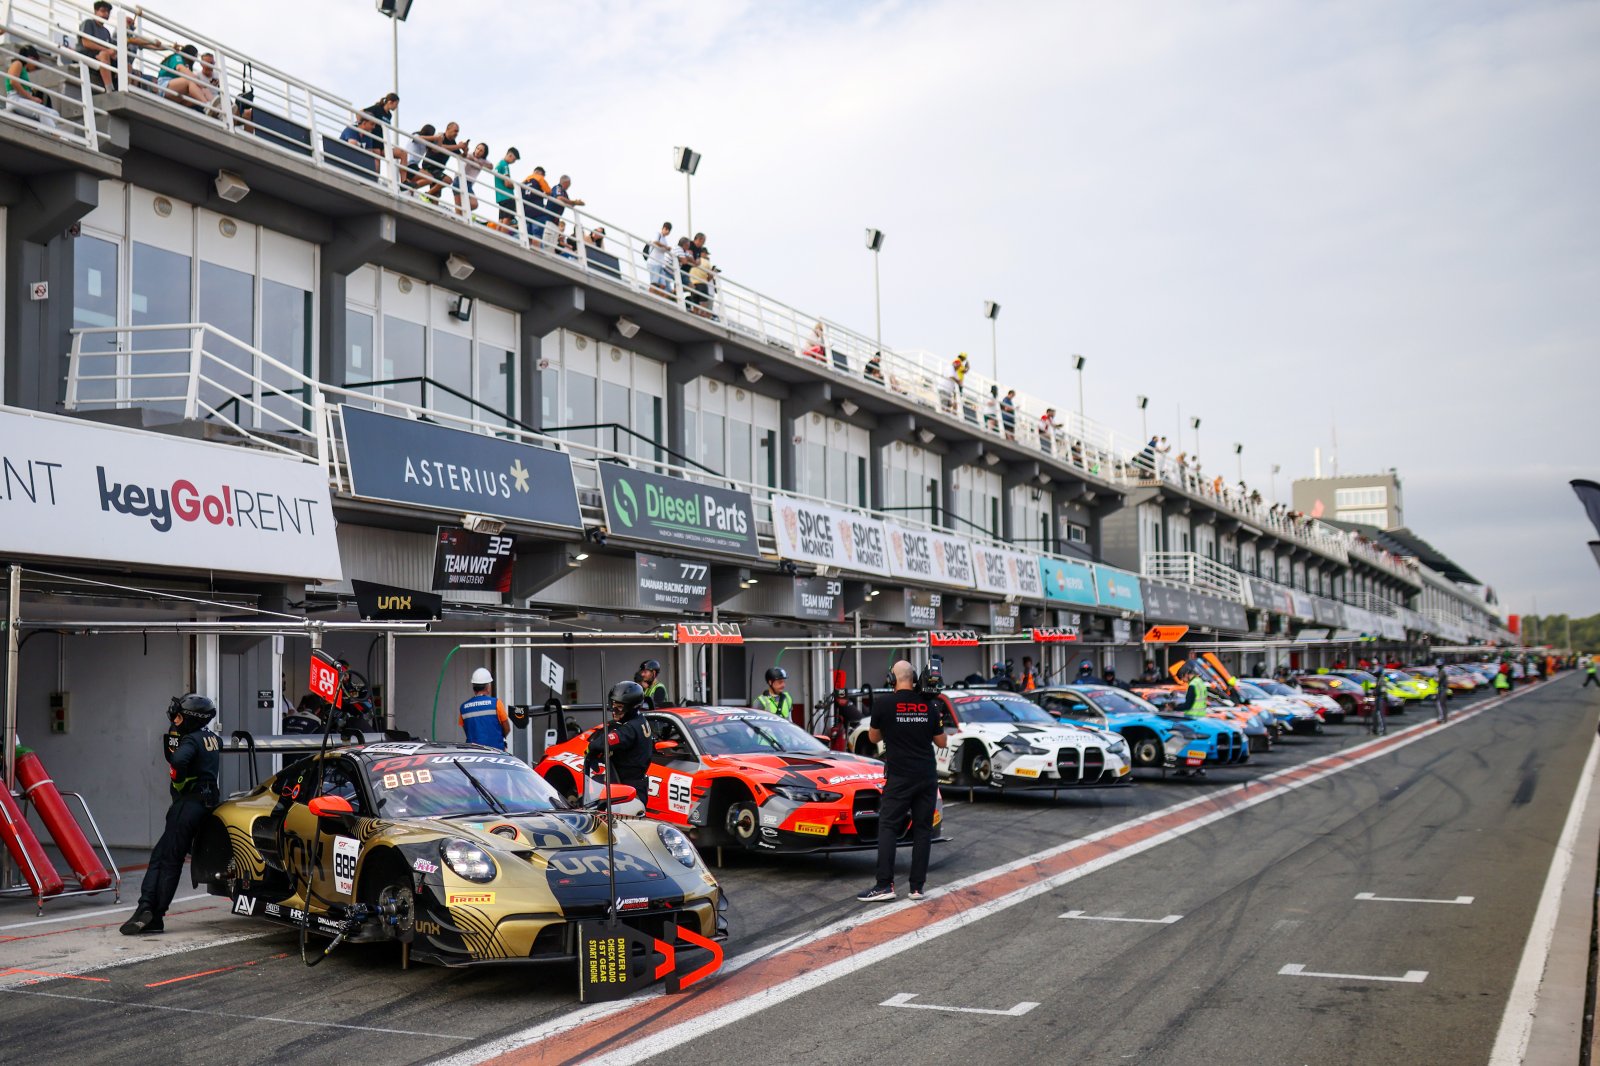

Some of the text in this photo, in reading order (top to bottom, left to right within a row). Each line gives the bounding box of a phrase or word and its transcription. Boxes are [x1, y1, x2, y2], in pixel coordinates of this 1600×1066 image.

[0, 456, 62, 506] NT
[404, 456, 511, 499] ASTERIUS
[645, 484, 748, 534] Diesel Parts
[798, 508, 833, 541] SPICE
[487, 536, 514, 556] 32
[852, 522, 882, 552] SPICE
[903, 532, 930, 560] SPICE
[801, 537, 834, 559] MONKEY
[856, 547, 884, 569] MONKEY
[943, 542, 968, 567] SPICE
[444, 554, 497, 575] TEAM WRT
[680, 563, 707, 581] 777
[906, 556, 931, 576] MONKEY
[664, 582, 684, 594] RACING
[684, 584, 692, 594] BY
[692, 585, 707, 596] WRT
[827, 581, 841, 595] 30
[801, 593, 834, 609] TEAM WRT
[910, 605, 929, 619] GARAGE
[319, 668, 335, 696] 32
[896, 702, 929, 713] SRO
[168, 737, 179, 747] aws
[383, 769, 433, 789] 888
[669, 783, 690, 804] 32
[798, 824, 825, 834] PIRELLI
[336, 852, 356, 879] 888
[340, 882, 352, 890] ROW
[450, 894, 491, 904] PIRELLI
[317, 916, 339, 929] DINAMIC
[589, 940, 598, 984] START ENGINE
[599, 958, 607, 982] GEAR
[607, 938, 617, 983] CHECK RADIO
[617, 938, 626, 982] DRIVER ID
